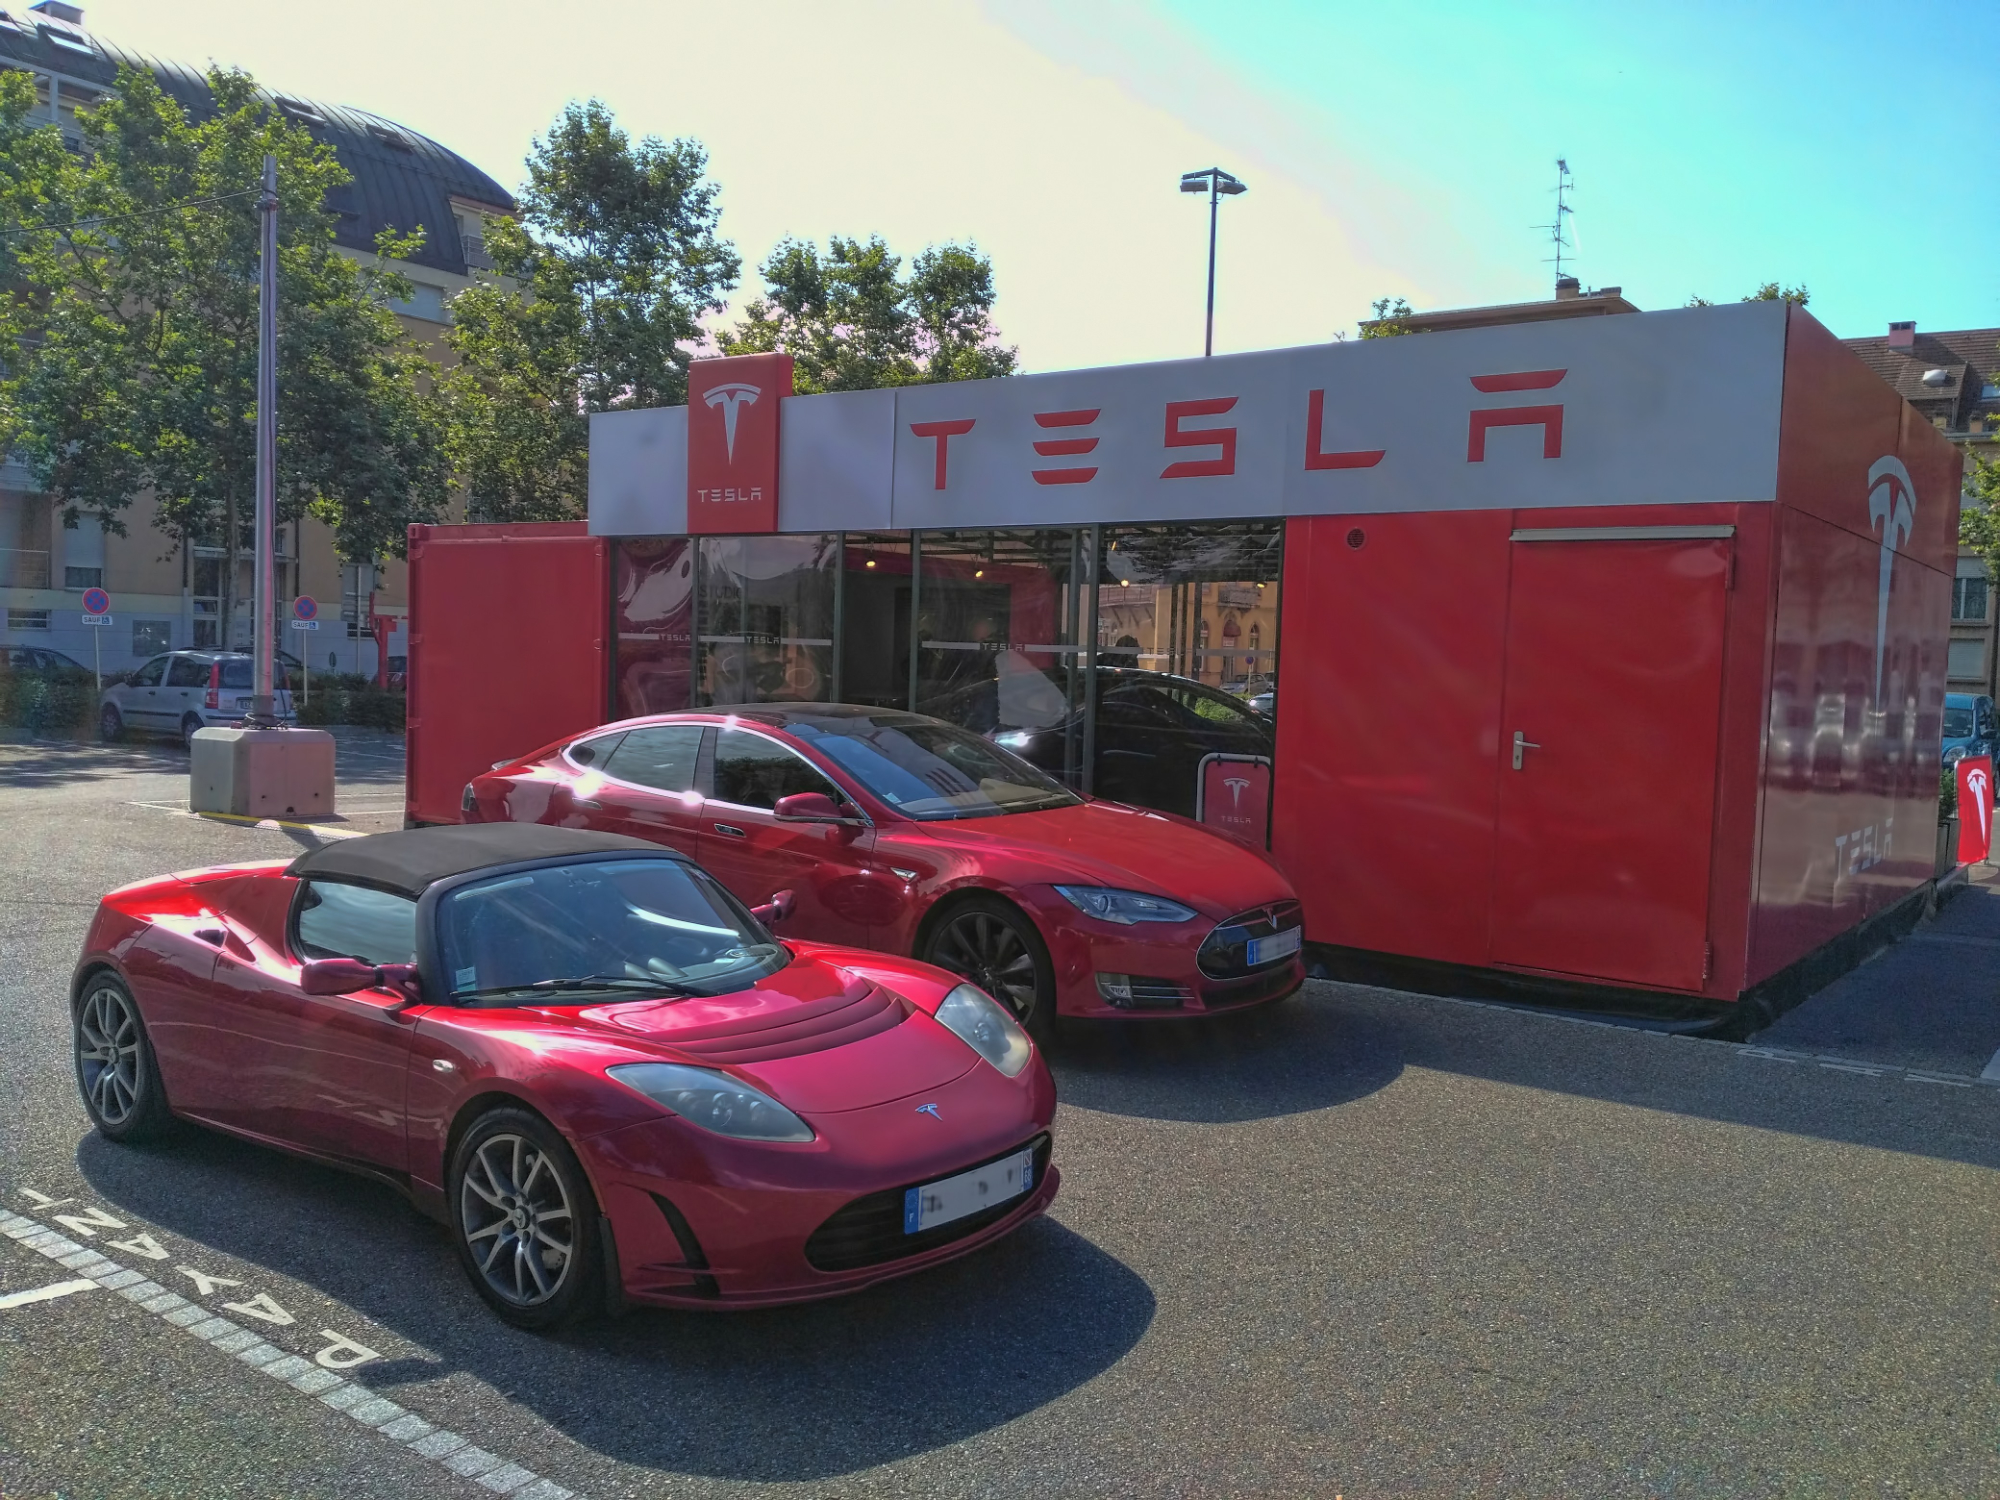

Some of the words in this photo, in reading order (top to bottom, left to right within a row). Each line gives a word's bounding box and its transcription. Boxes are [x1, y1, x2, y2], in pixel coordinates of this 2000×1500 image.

[910, 368, 1568, 491] TESLA
[697, 486, 762, 503] TESLA
[660, 633, 691, 642] TESLA
[746, 636, 780, 645] TESLA
[982, 642, 1024, 652] TESLA
[1221, 815, 1251, 824] TESLA
[1835, 817, 1894, 883] TESLA
[18, 1187, 382, 1369] PAYANT
